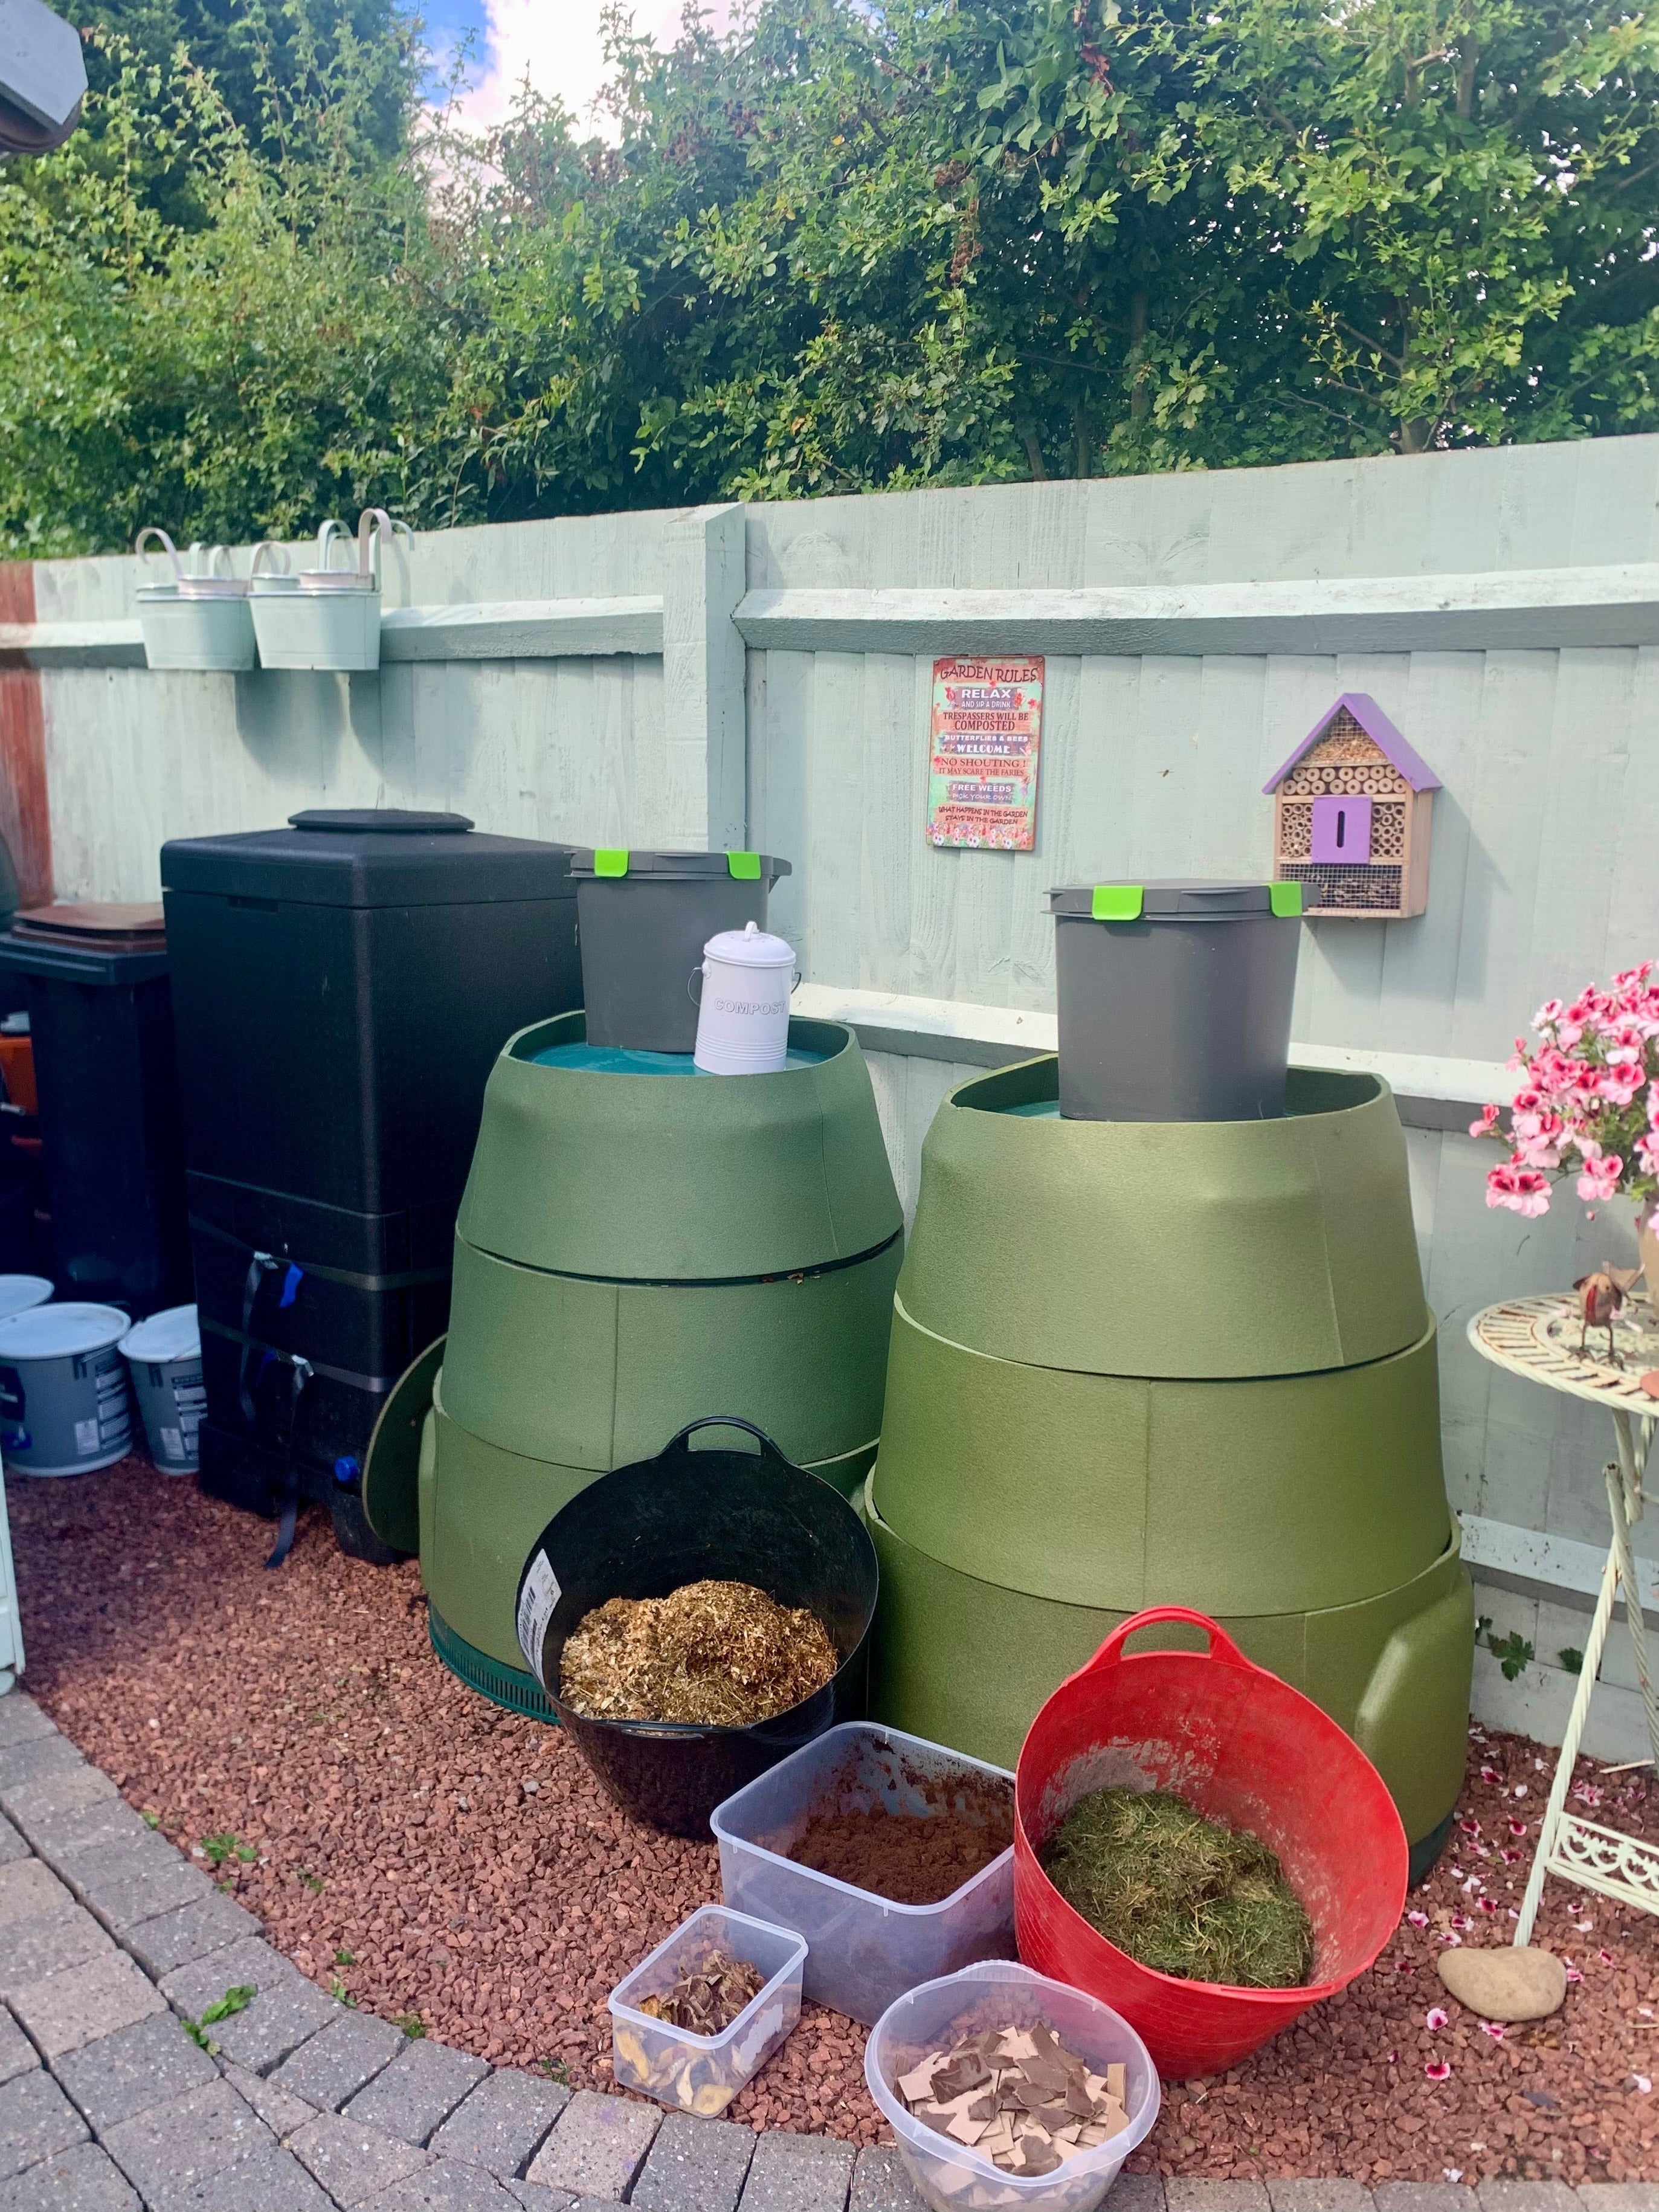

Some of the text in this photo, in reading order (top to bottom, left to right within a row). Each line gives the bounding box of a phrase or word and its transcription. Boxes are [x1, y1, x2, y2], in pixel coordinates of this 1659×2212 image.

[941, 665, 1038, 682] GARDEN RULES
[961, 689, 1011, 698] RELAX
[955, 720, 1015, 730] COMPOSTED
[957, 744, 1010, 753] WELCOME
[960, 759, 1020, 767] SHOUTING
[956, 807, 982, 815] HAPPENS
[715, 998, 785, 1015] COMPOST
